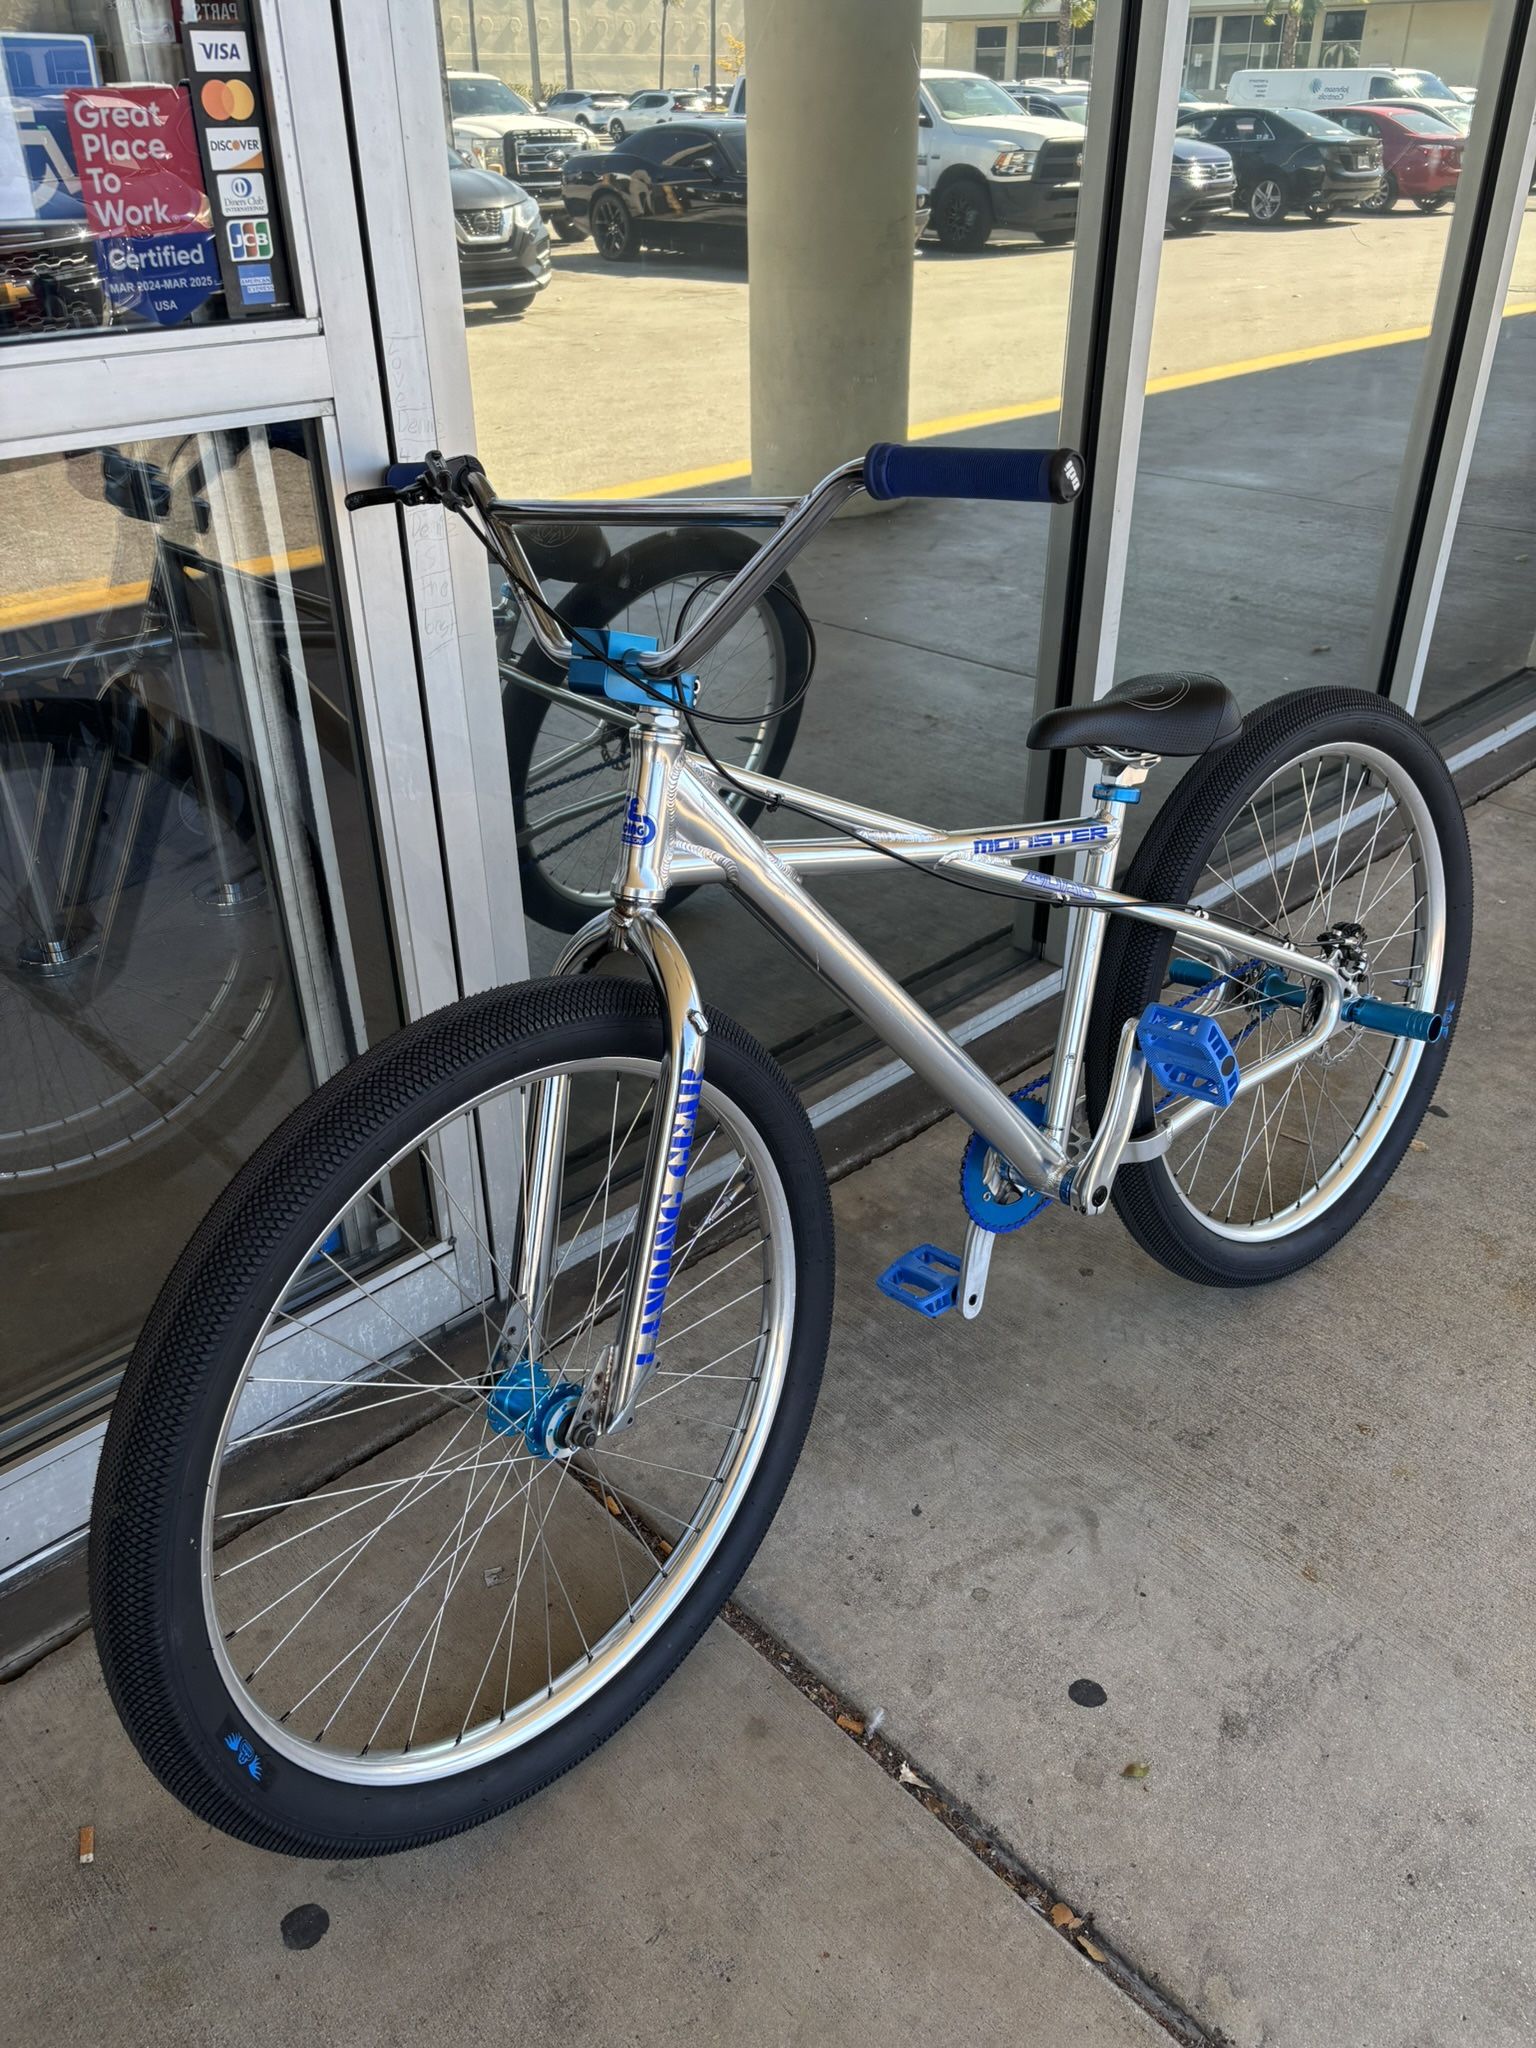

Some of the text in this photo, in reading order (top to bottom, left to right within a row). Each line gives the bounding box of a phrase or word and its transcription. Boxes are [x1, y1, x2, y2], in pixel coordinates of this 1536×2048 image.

[197, 42, 241, 60] VISA
[73, 99, 162, 129] Great
[81, 133, 167, 161] Place
[210, 139, 260, 151] DISCOVER
[85, 167, 121, 194] To
[224, 194, 264, 207] Diners Club
[231, 232, 269, 248] JCB
[108, 243, 205, 271] Certified
[110, 282, 135, 294] MAR
[190, 276, 213, 287] 2025
[153, 300, 178, 312] USA
[973, 826, 1109, 854] MONSTER
